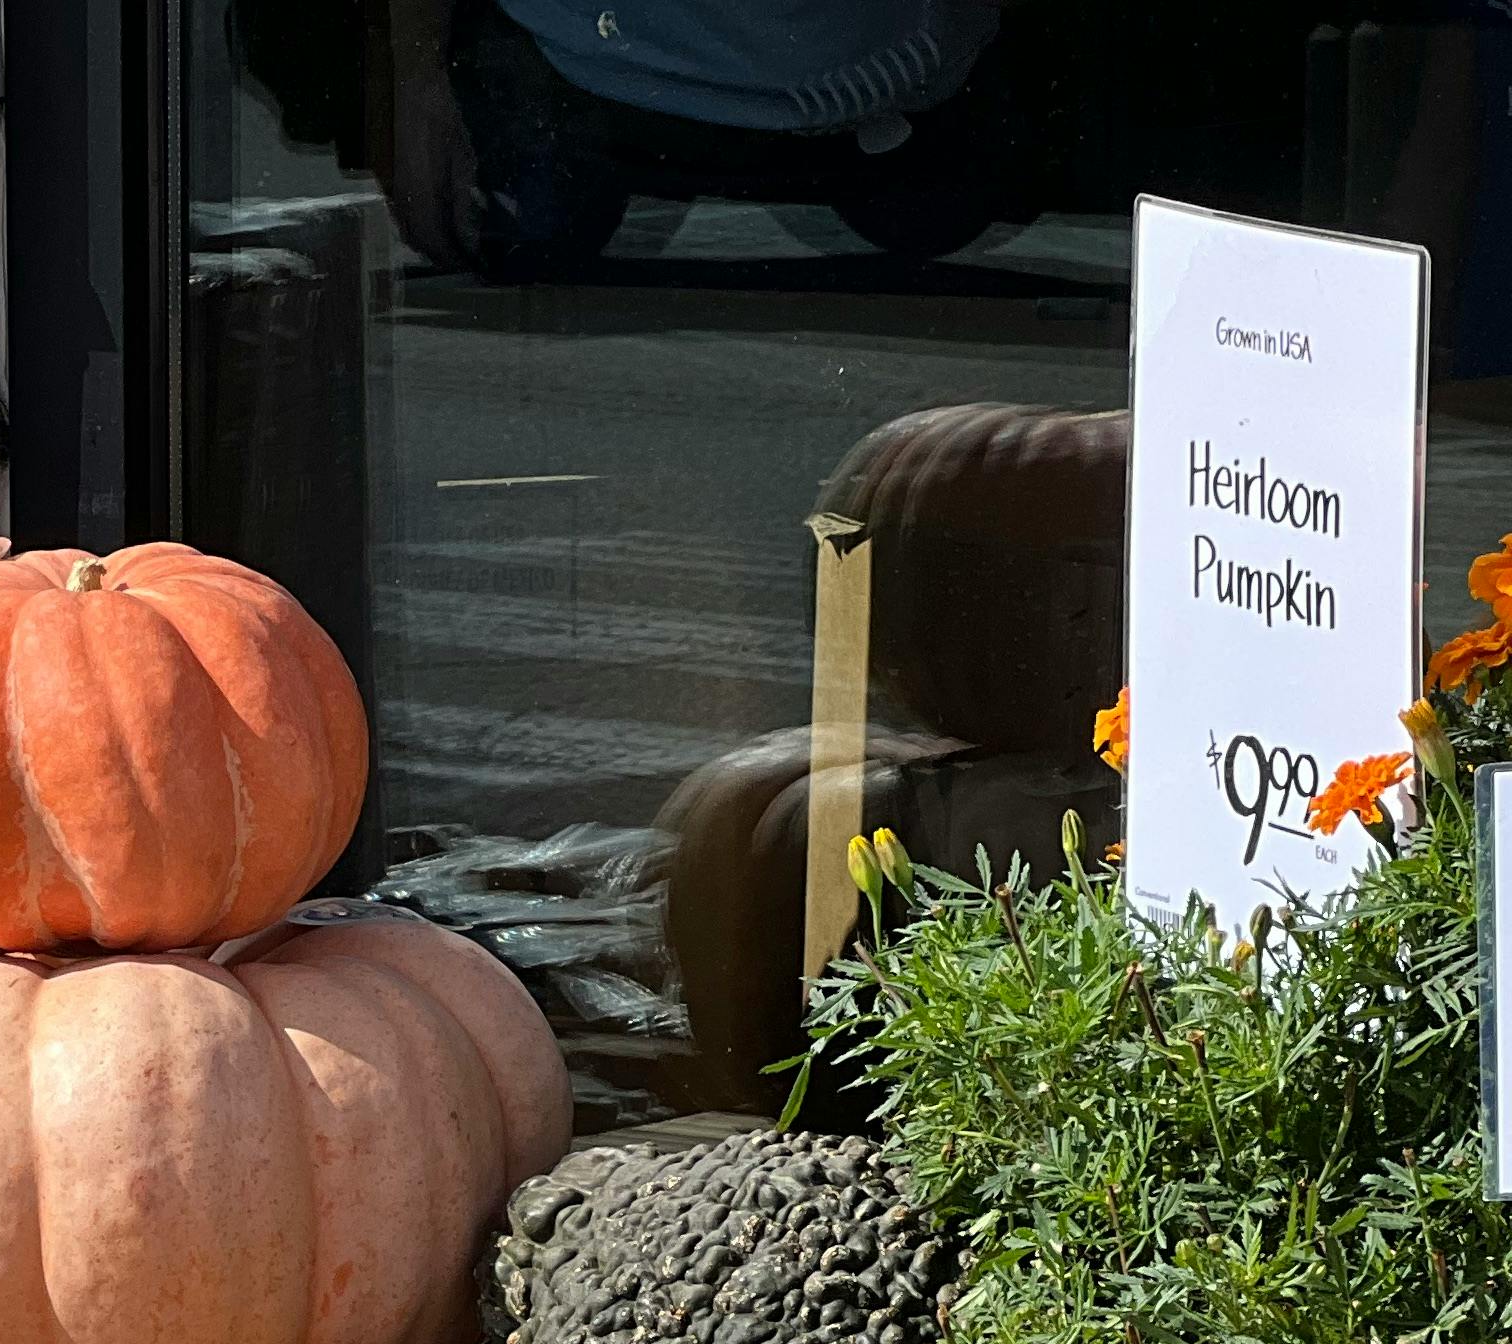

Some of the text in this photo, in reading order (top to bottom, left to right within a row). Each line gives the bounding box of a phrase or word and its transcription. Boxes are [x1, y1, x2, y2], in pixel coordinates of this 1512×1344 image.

[1215, 315, 1313, 364] Grown in USA
[1189, 440, 1341, 539] Heirloom
[1194, 534, 1336, 630] Pumpkin
[1314, 844, 1338, 865] EACH
